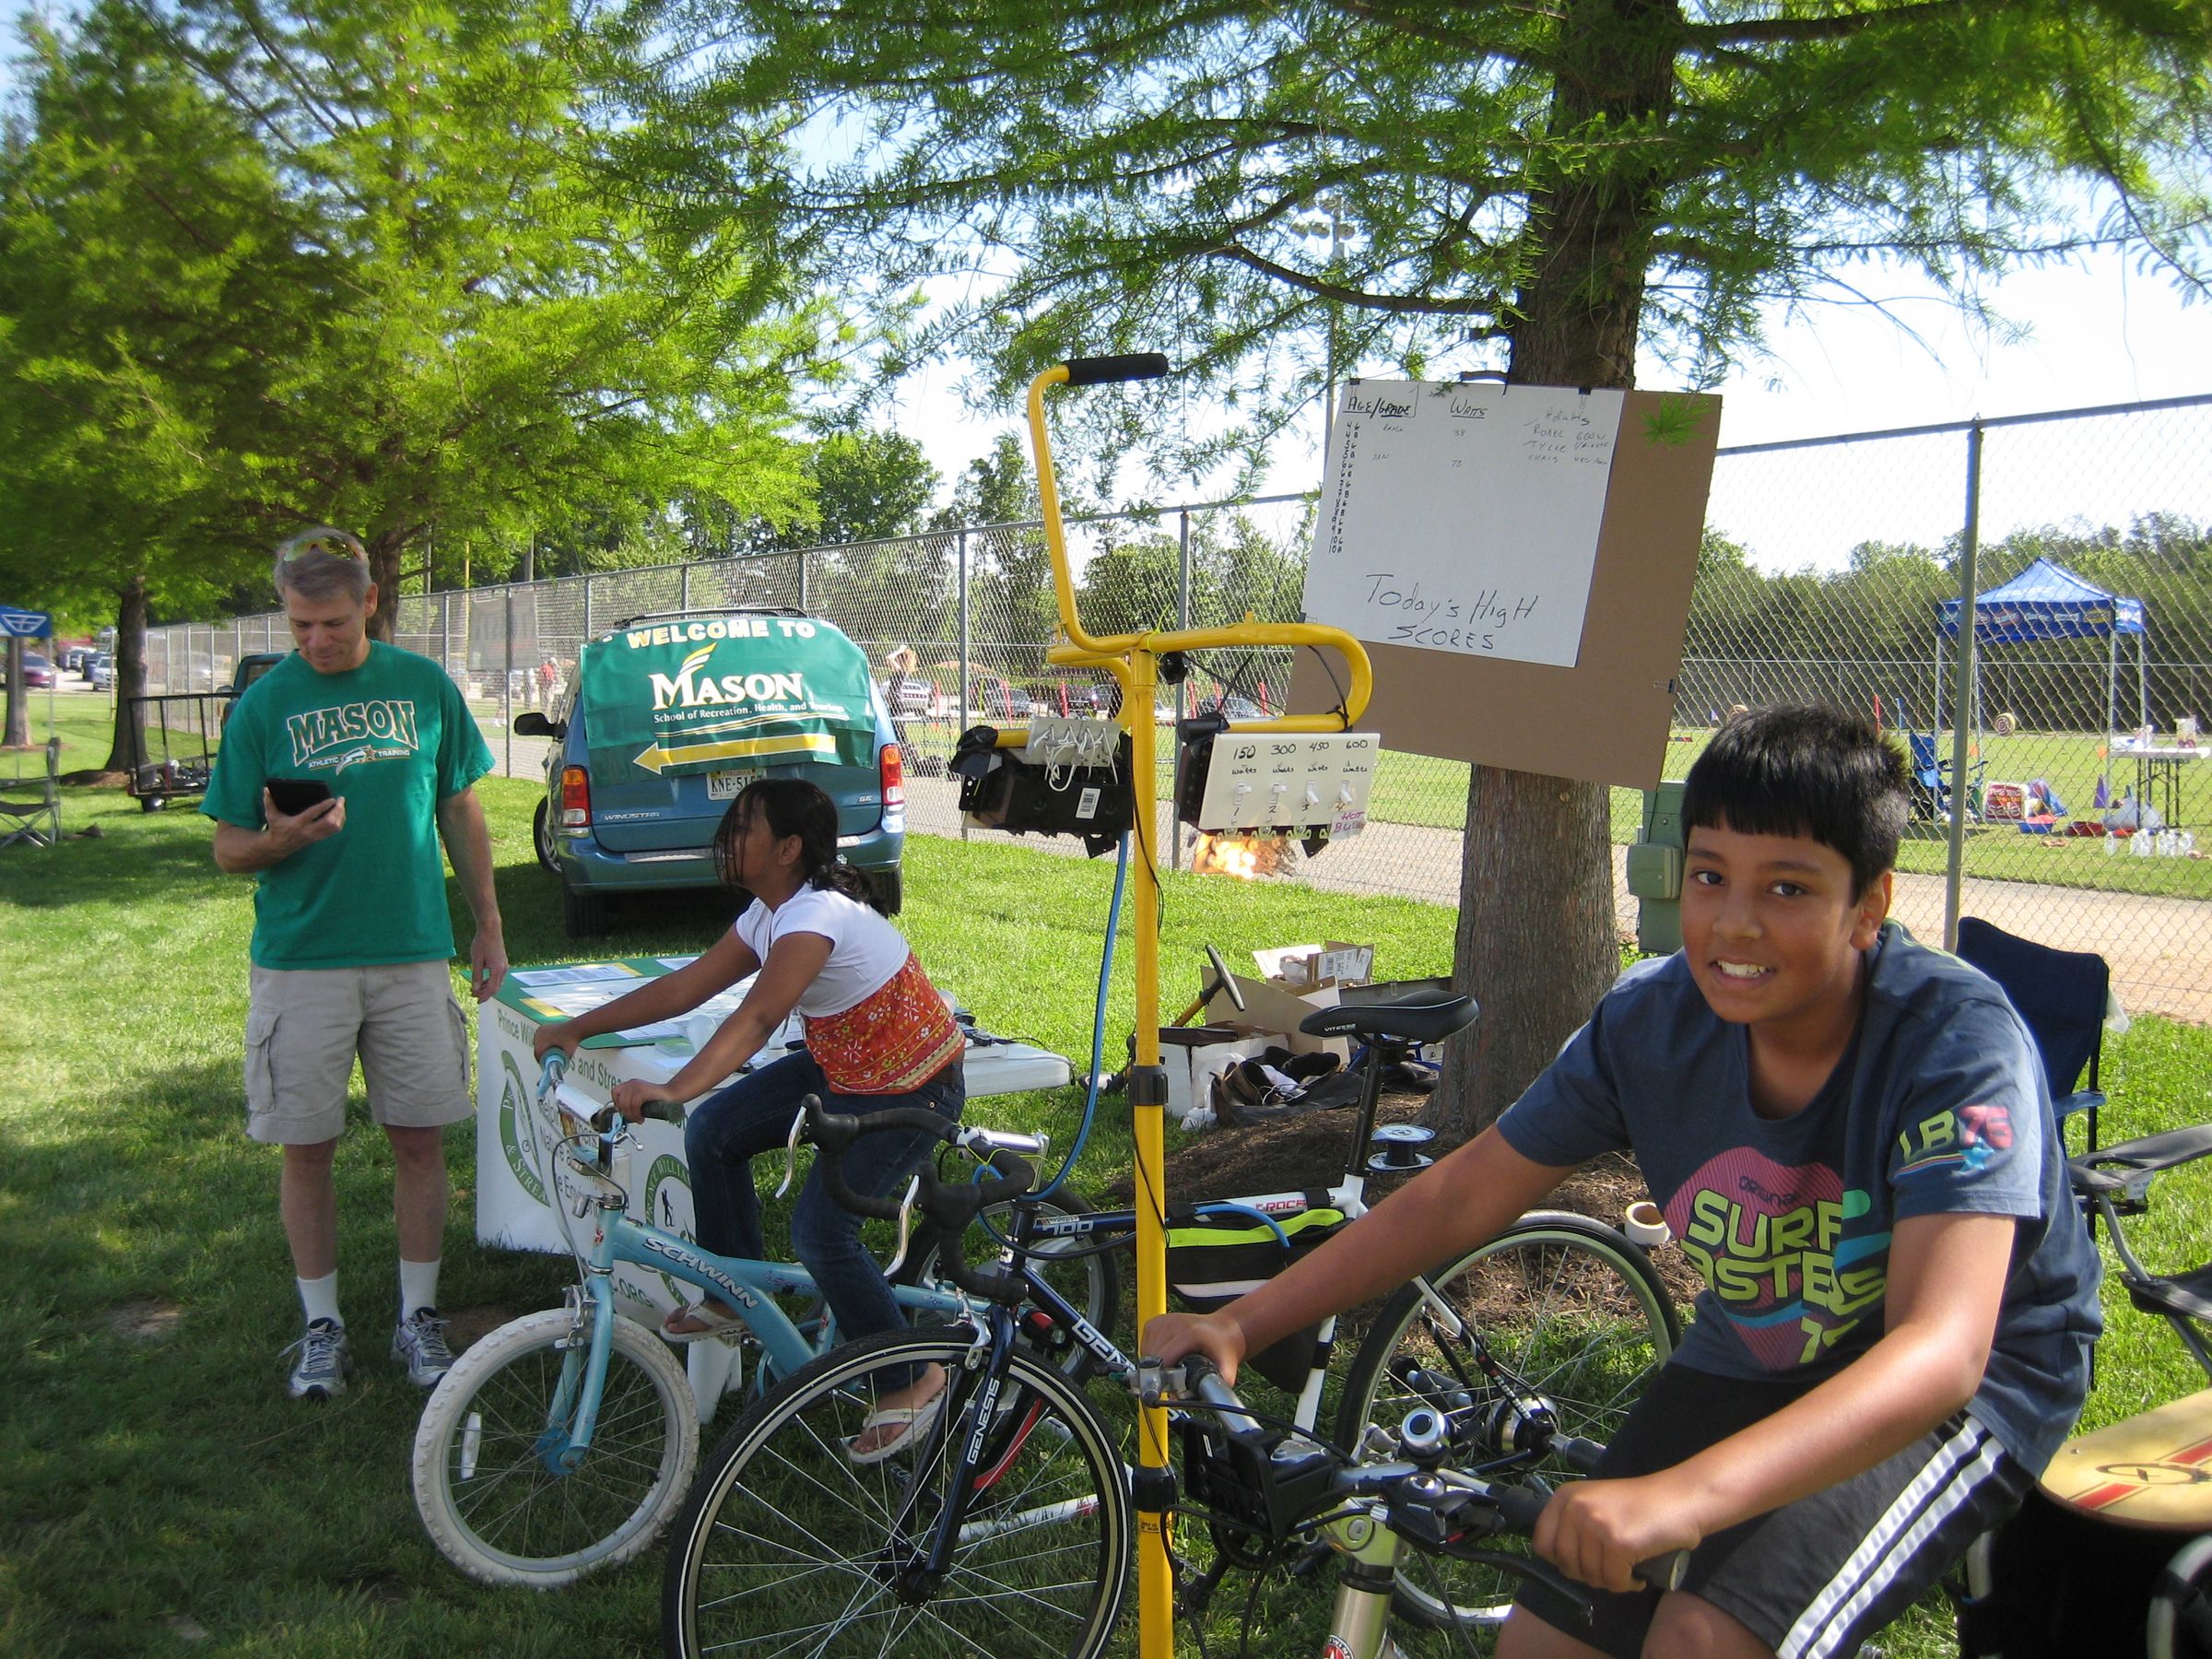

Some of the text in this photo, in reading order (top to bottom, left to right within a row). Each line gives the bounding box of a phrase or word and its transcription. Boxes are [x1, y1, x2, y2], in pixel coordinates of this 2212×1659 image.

[627, 618, 816, 649] WELCOME TO
[1388, 625, 1495, 649] SCORES
[653, 712, 685, 724] School
[687, 710, 699, 720] of
[790, 701, 806, 711] and
[287, 700, 419, 767] MASON
[1233, 739, 1369, 759] 150 300 450 600
[308, 757, 340, 769] ATHLETIC
[605, 811, 660, 820] WINDSTAR
[1300, 804, 1310, 812] 3
[498, 1008, 520, 1040] Prince
[578, 1057, 595, 1081] and
[1688, 1188, 1843, 1259] SURF
[643, 1238, 759, 1310] SCHWINN
[967, 1377, 1000, 1465] GENESIS
